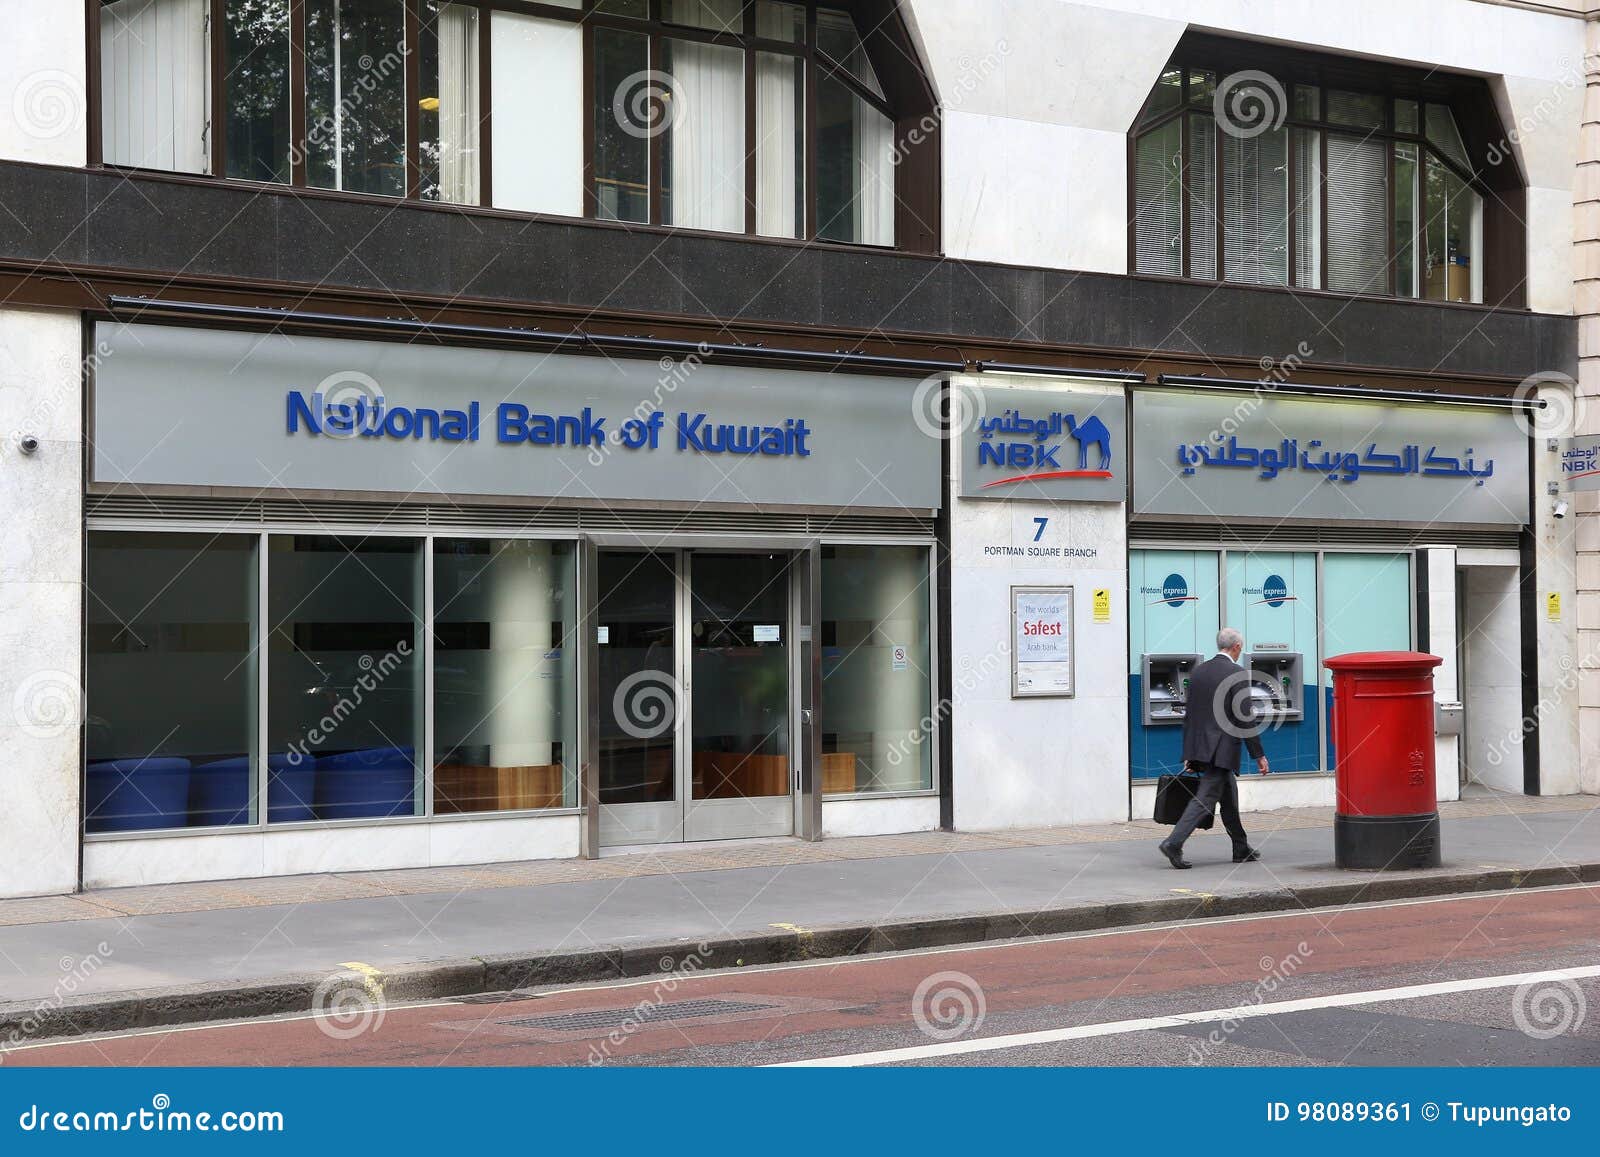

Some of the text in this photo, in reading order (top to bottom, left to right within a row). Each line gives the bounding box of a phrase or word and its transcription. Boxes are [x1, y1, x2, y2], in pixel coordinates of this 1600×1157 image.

[285, 390, 811, 457] National Bank of Kuwait
[979, 409, 1062, 442] الوطني
[979, 441, 1062, 468] NBK
[1178, 435, 1494, 487] بنك الكويت الوطني
[1562, 459, 1597, 472] NBK
[1033, 517, 1049, 542] 7
[984, 546, 1097, 558] PORTMAN SQUARE BRANCH
[1163, 587, 1187, 597] express
[1264, 587, 1286, 597] express
[1024, 620, 1062, 636] Safest
